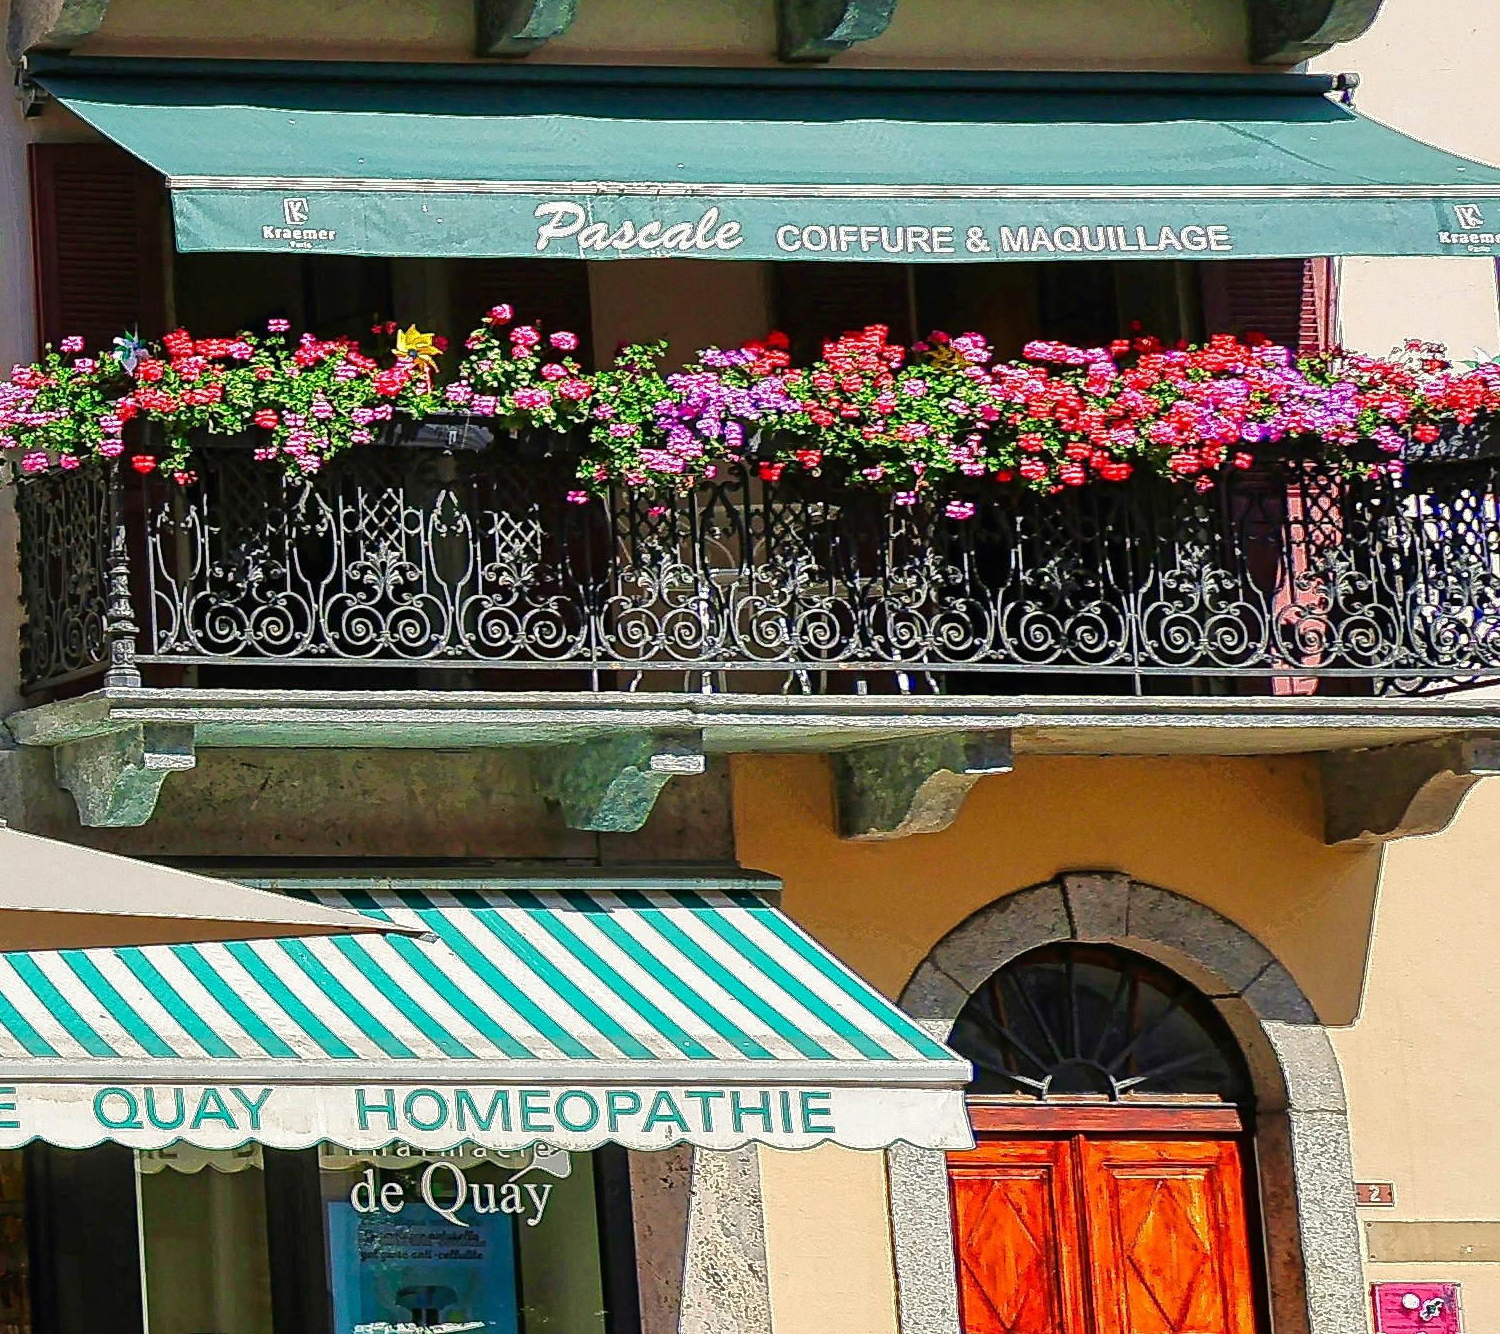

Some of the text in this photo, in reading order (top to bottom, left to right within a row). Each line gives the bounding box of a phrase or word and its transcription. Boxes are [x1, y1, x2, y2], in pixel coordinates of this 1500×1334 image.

[262, 225, 336, 240] Kraemer
[534, 200, 1234, 253] Pascale COIFFURE & MAQUILLAGE
[93, 1086, 274, 1130] QUAY
[354, 1088, 836, 1134] HOMEOPATHIE
[350, 1169, 405, 1213] de
[1368, 1185, 1381, 1201] 2
